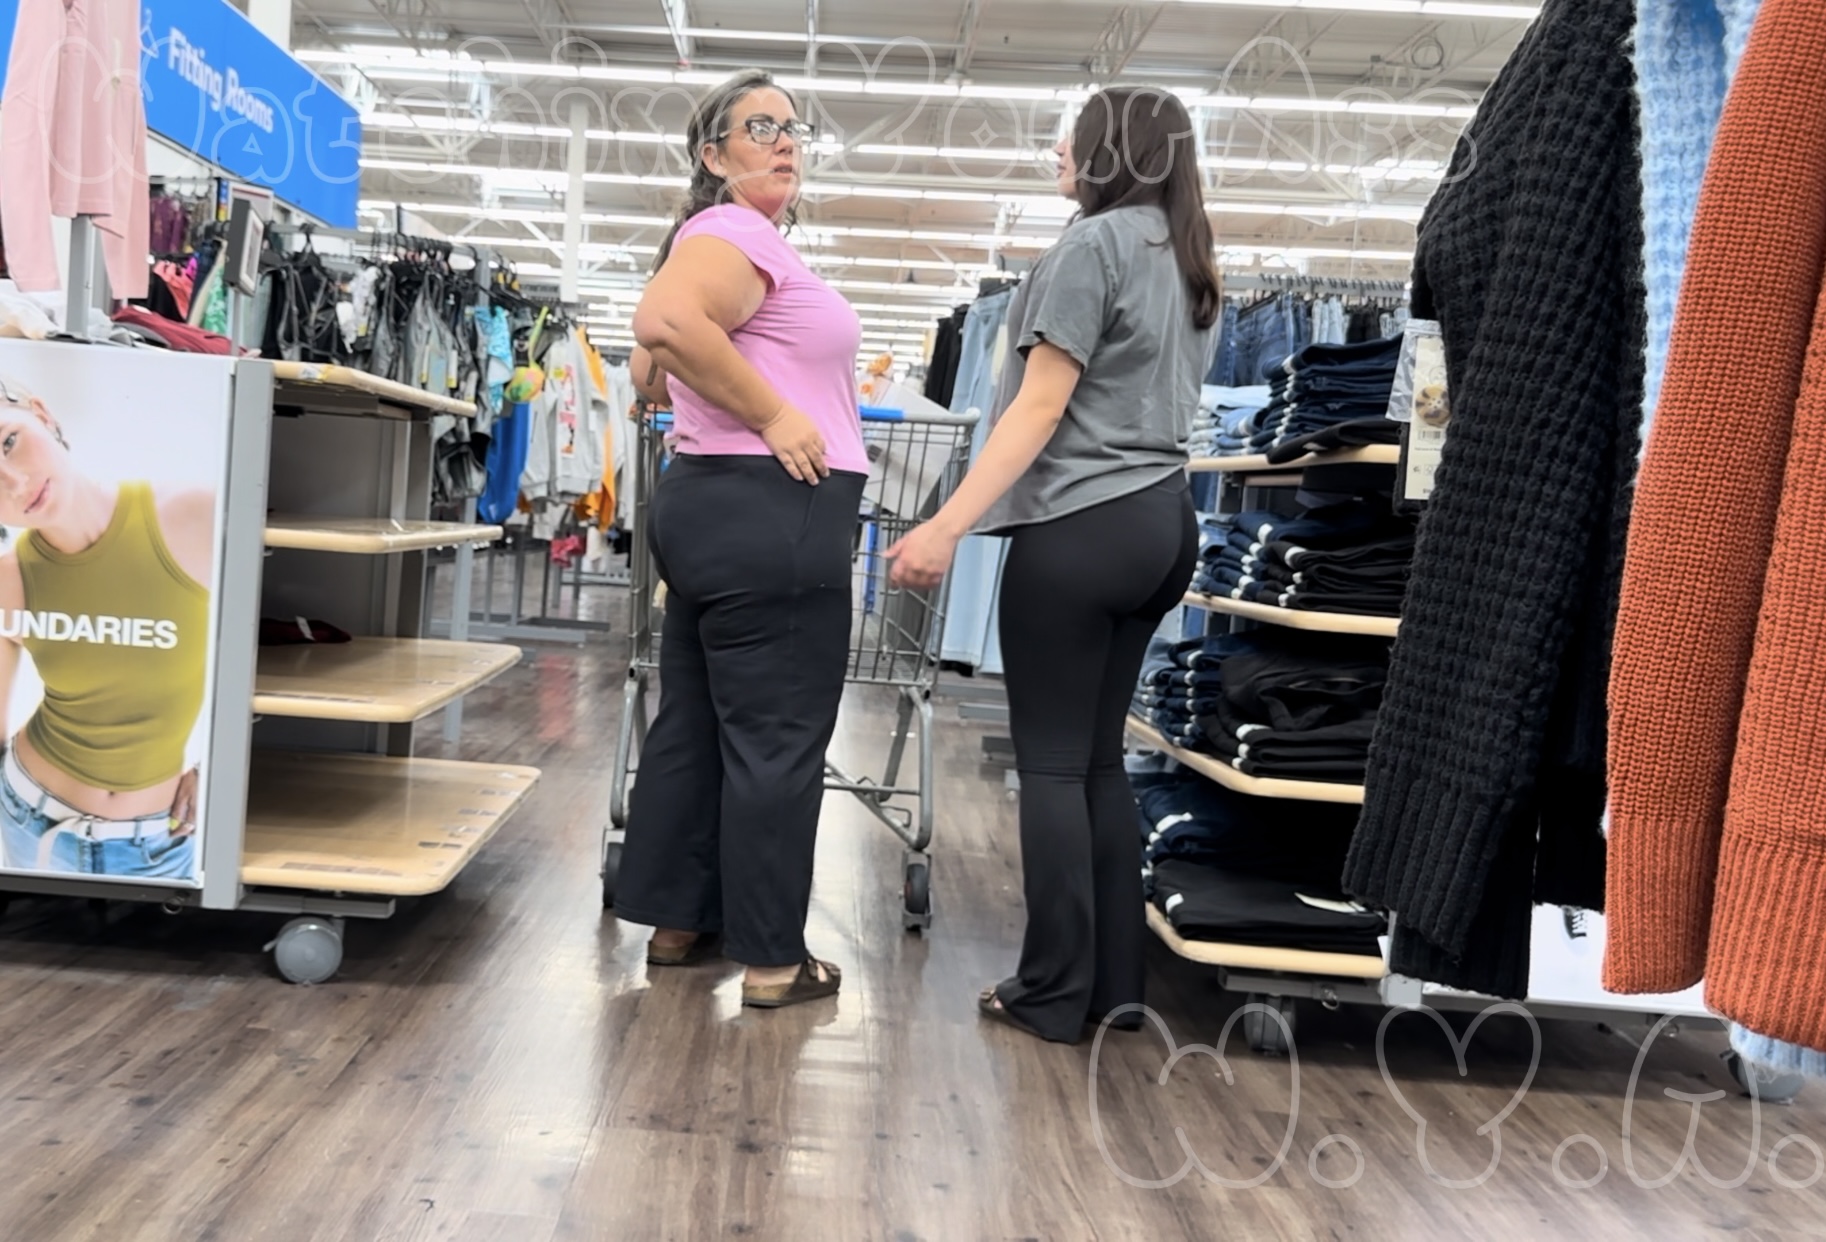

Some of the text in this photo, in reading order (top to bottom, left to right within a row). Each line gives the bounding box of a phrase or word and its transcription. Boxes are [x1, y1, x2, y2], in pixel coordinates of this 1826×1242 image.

[169, 26, 274, 134] Fitting Rooms
[0, 609, 178, 649] UNDARIES
